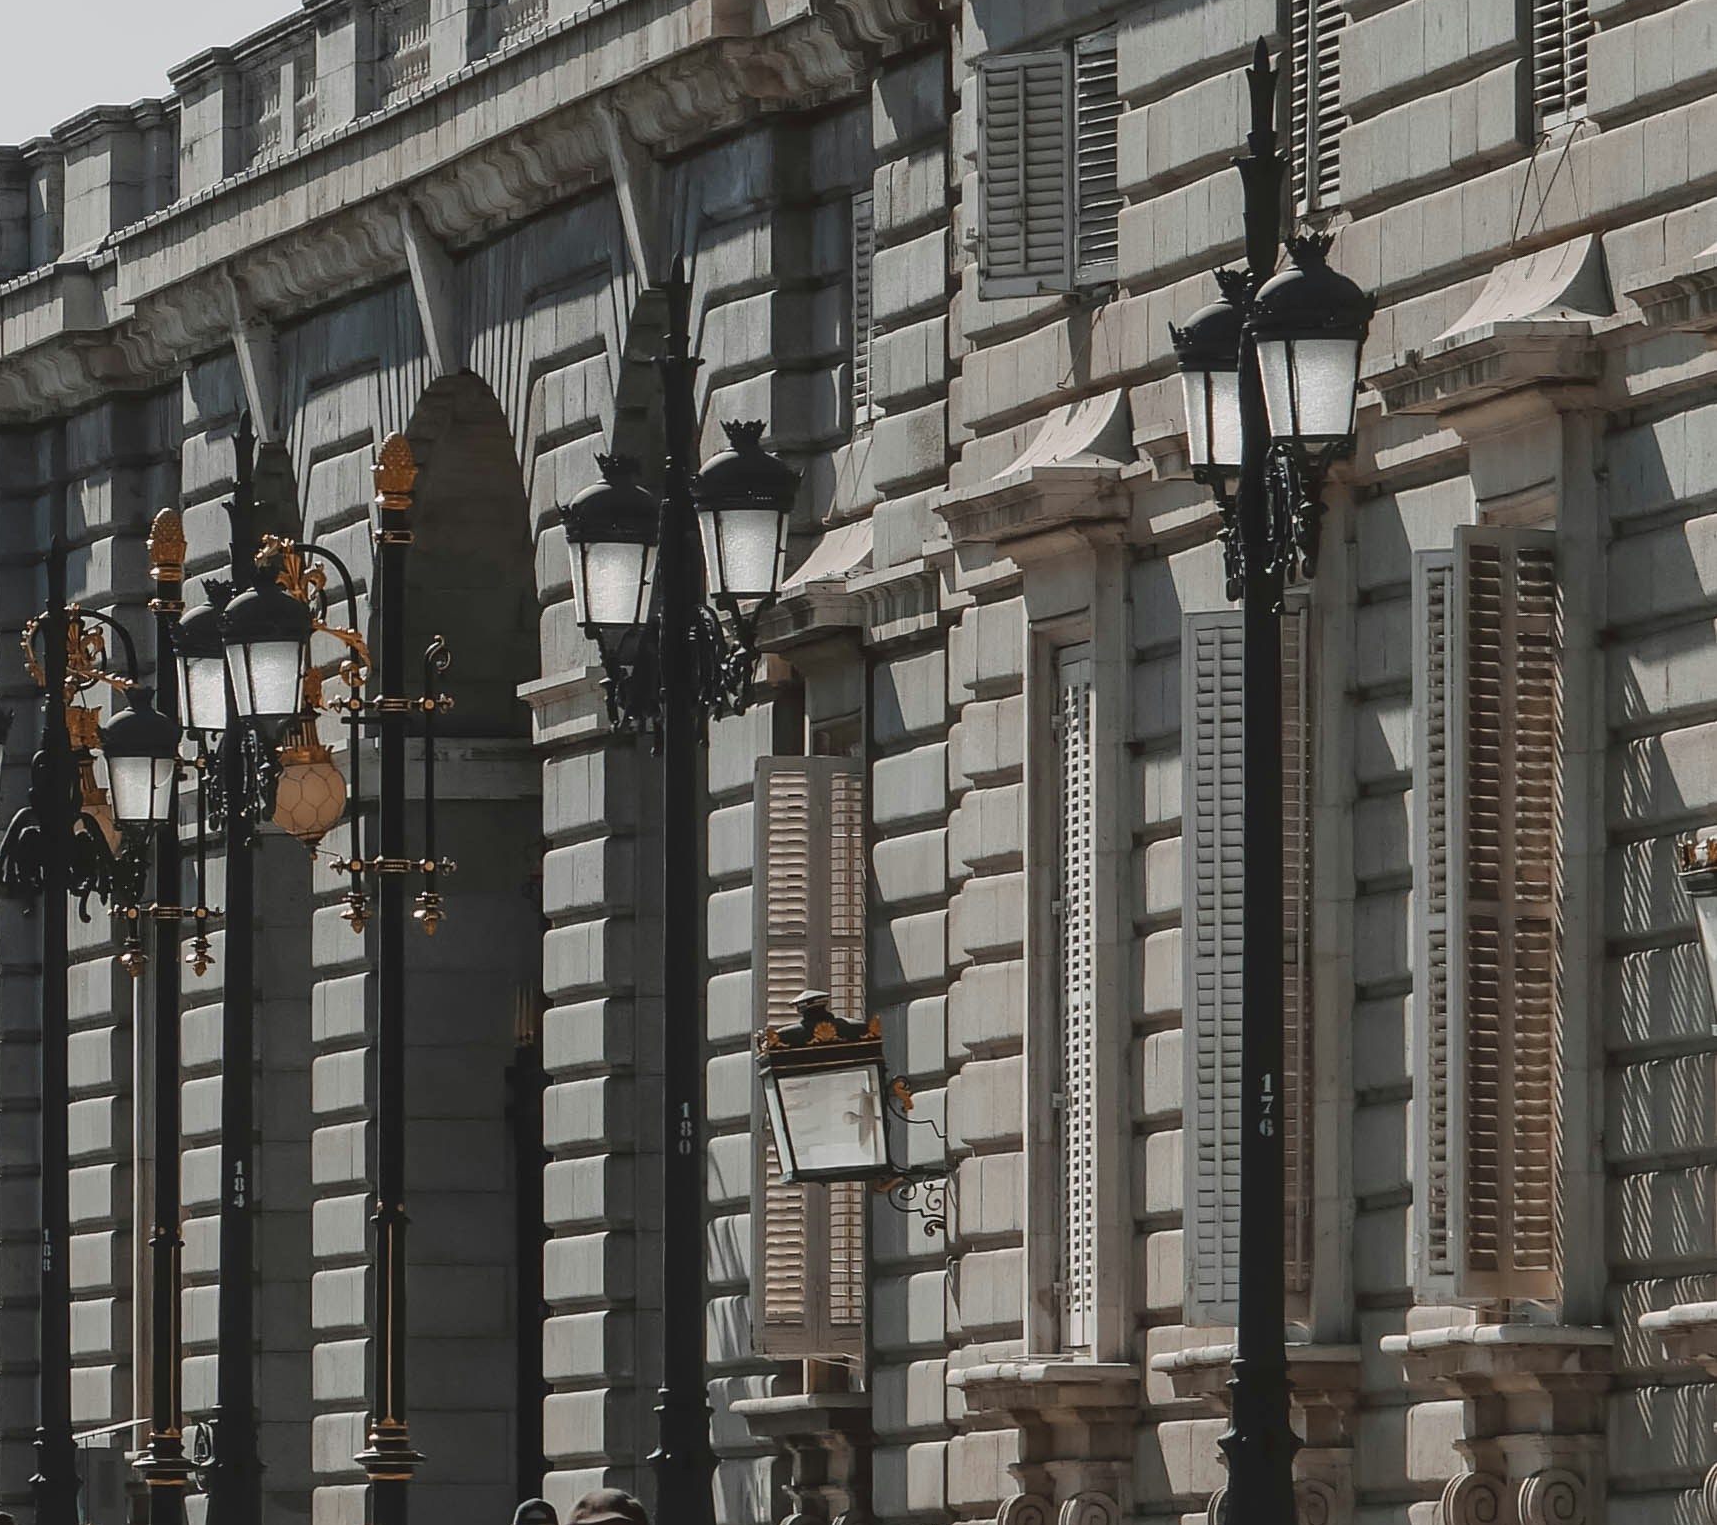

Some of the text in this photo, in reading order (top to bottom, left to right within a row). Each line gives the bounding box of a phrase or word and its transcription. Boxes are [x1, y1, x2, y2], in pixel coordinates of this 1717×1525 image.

[678, 1102, 691, 1155] 180
[1258, 1073, 1274, 1137] 176
[233, 1159, 245, 1208] 184
